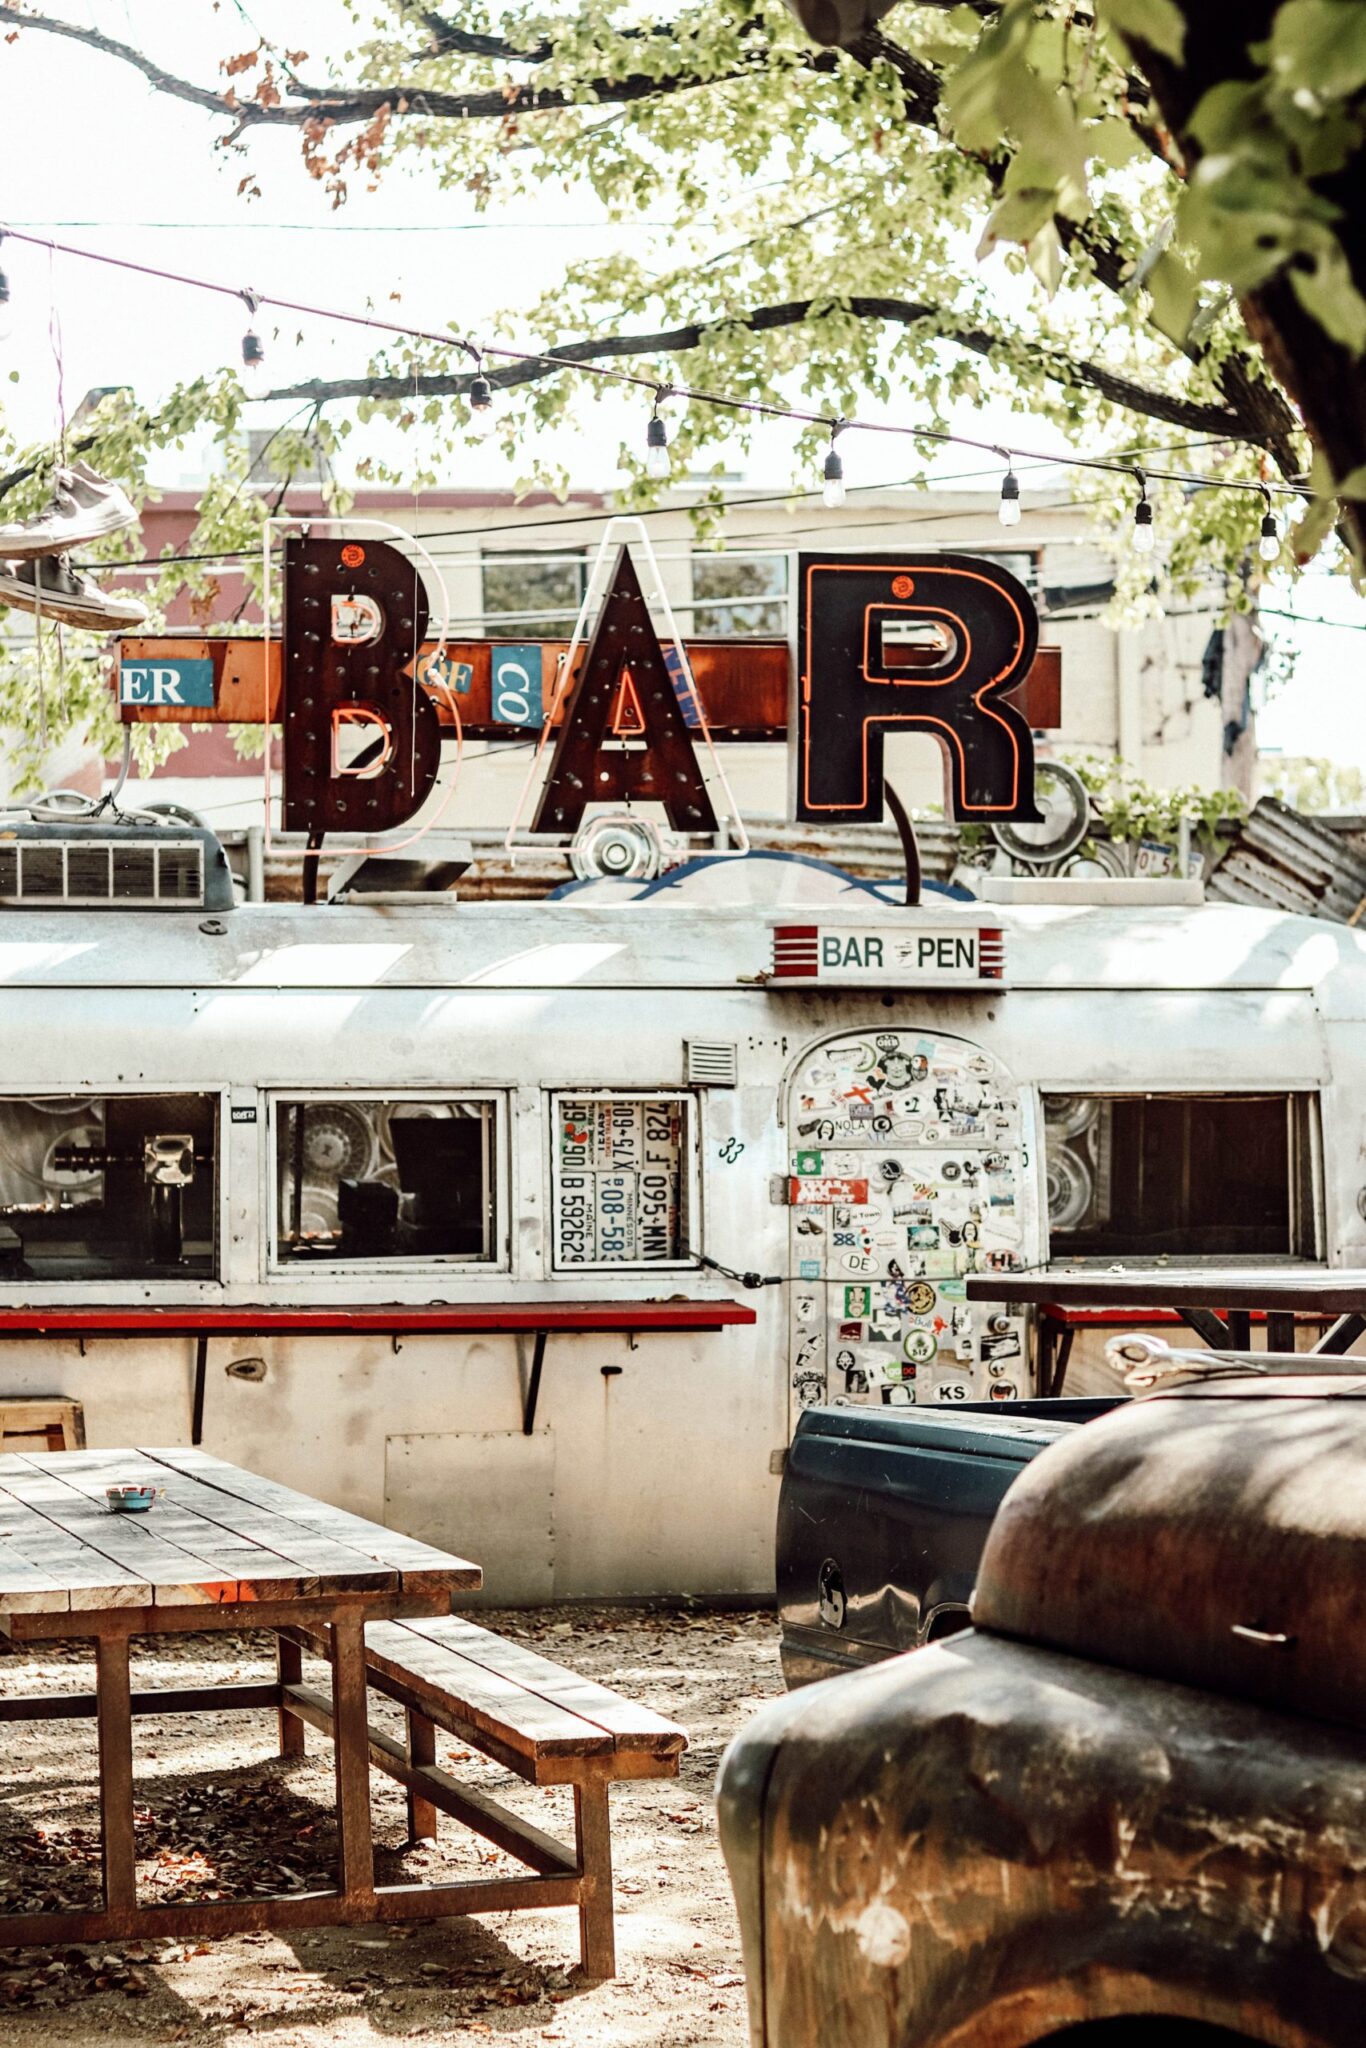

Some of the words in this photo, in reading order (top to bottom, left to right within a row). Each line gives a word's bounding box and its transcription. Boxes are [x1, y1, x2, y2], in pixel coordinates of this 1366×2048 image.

[121, 668, 185, 703] ER
[283, 538, 1046, 833] BAR
[497, 663, 529, 723] CO
[822, 936, 884, 967] BAR
[893, 937, 975, 968] PEN
[835, 1120, 865, 1130] NOLA
[718, 1136, 745, 1164] 33
[561, 1177, 584, 1188] B
[626, 1193, 634, 1248] MINNESOTA
[849, 1255, 871, 1272] DE
[939, 1386, 966, 1400] KS
